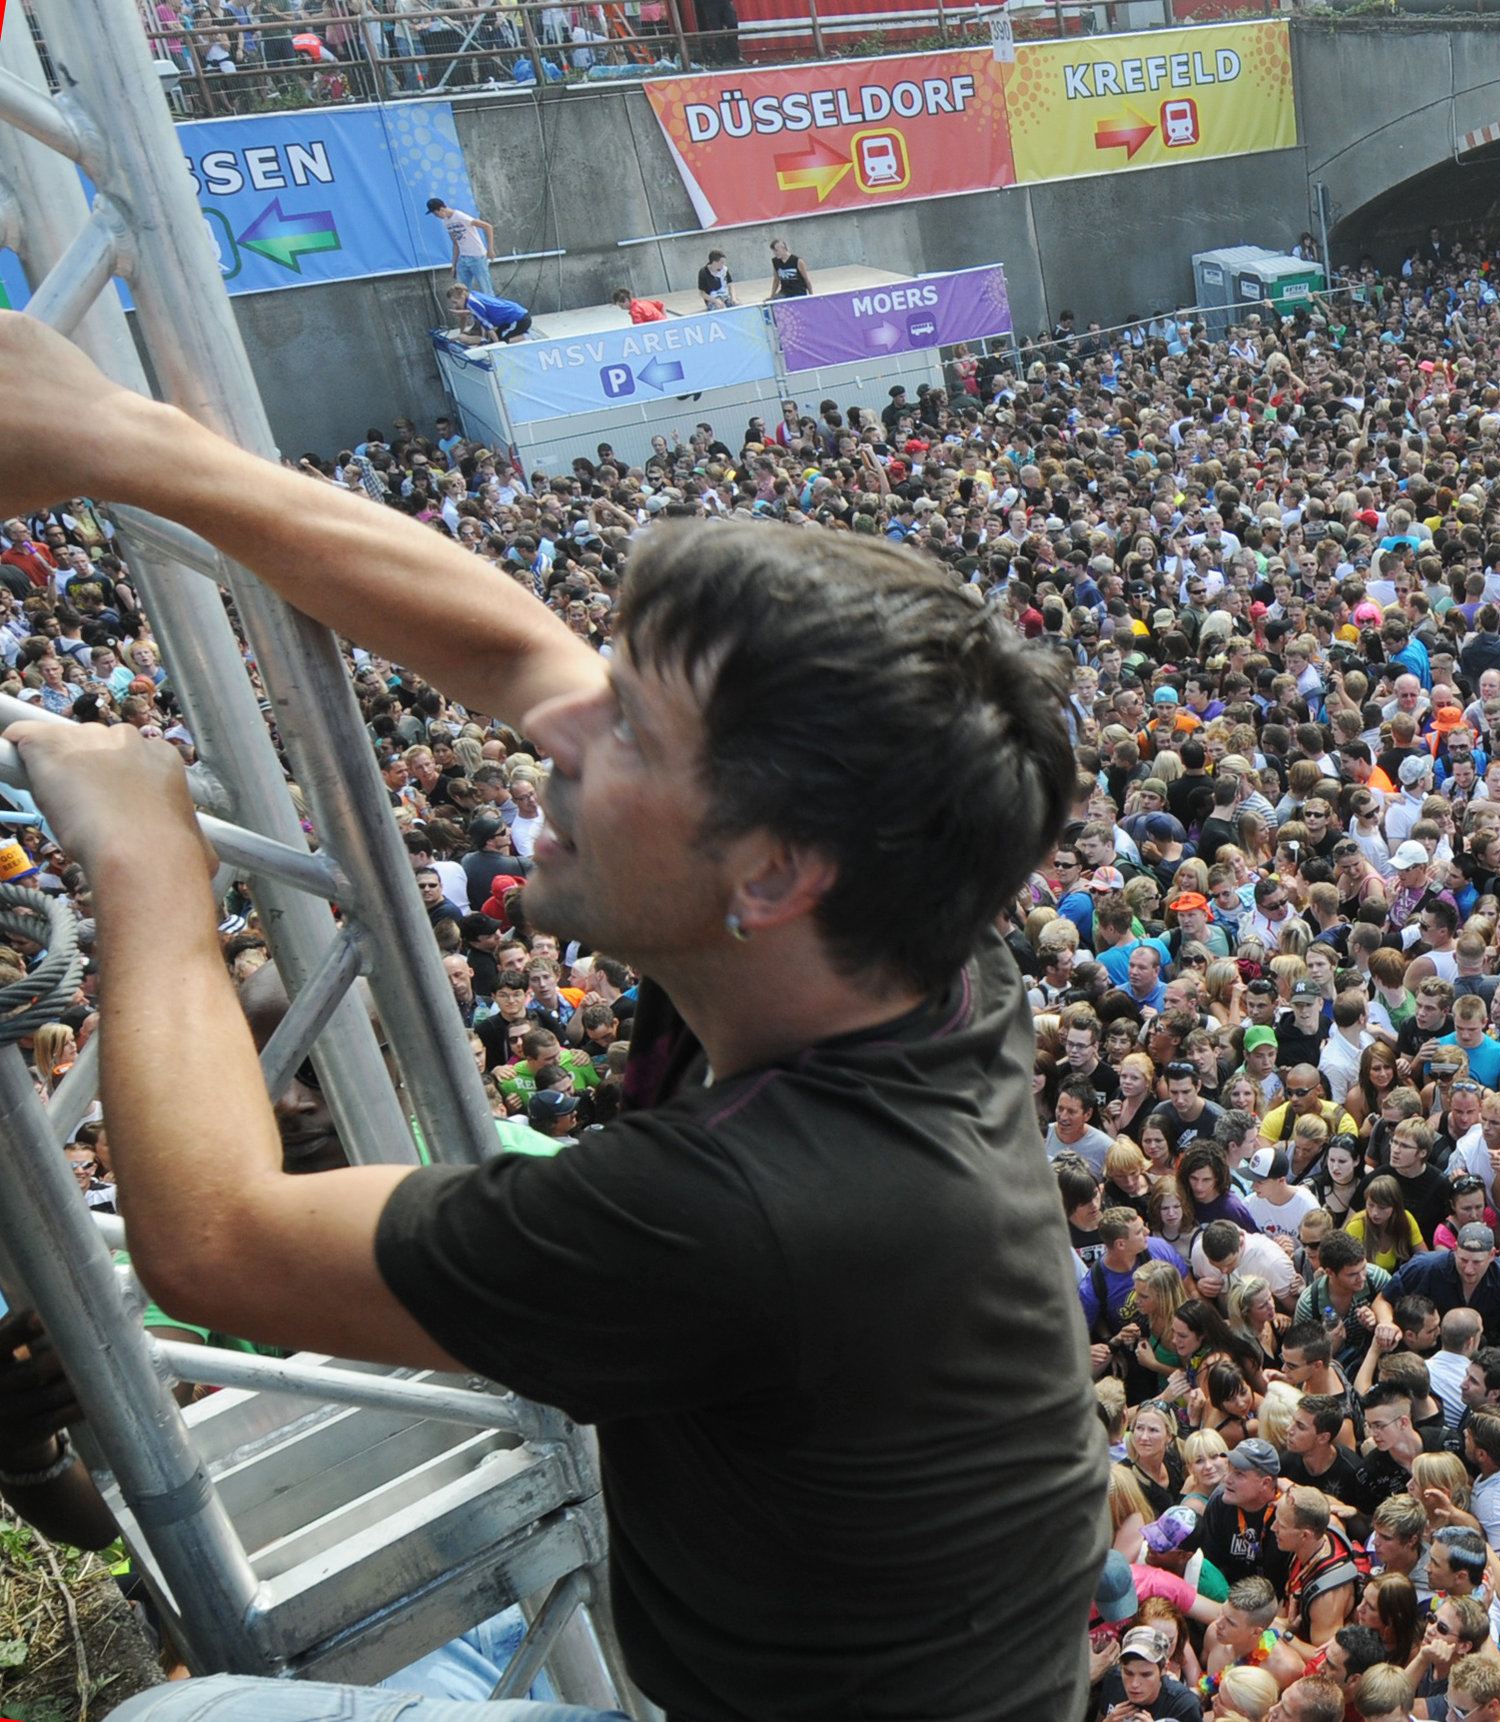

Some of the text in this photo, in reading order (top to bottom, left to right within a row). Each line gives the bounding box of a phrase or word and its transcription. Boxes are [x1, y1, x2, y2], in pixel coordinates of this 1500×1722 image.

[991, 20, 1011, 40] 390
[1063, 49, 1243, 100] KREFELD
[684, 75, 976, 143] DÜSSELDORF
[182, 140, 335, 196] SEN
[852, 285, 939, 318] MOERS
[538, 322, 727, 372] MSV ARENA
[608, 368, 627, 394] P
